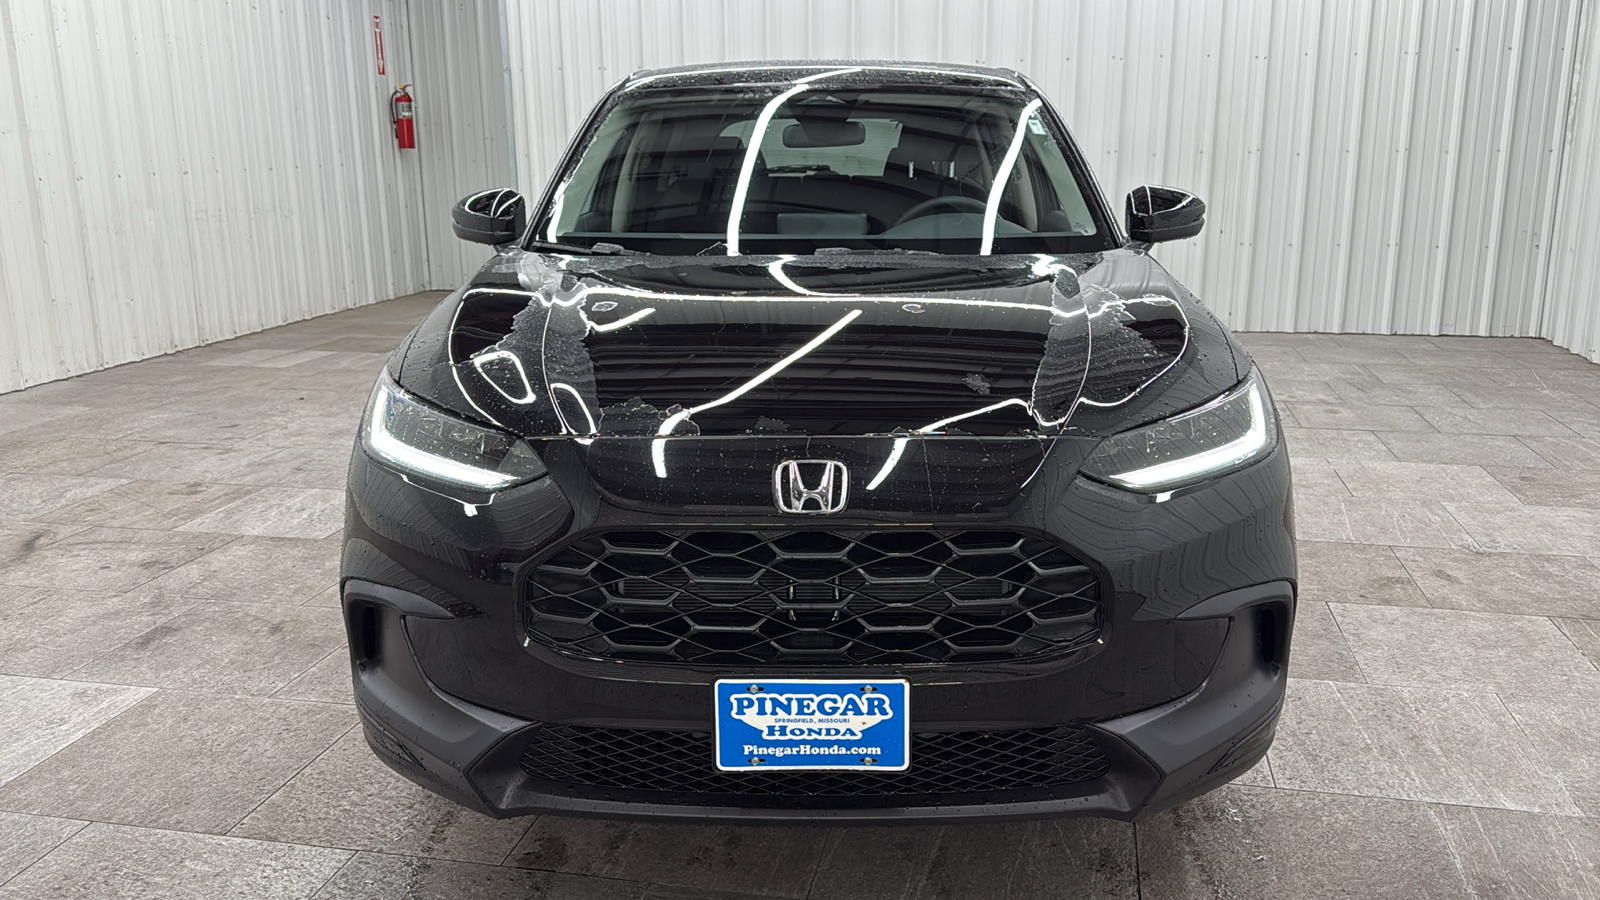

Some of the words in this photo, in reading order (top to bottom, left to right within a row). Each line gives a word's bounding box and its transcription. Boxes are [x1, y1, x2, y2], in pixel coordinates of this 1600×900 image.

[734, 697, 890, 716] PINEGAR
[766, 725, 859, 737] HONDA
[743, 745, 881, 757] PinegarHonda.com
